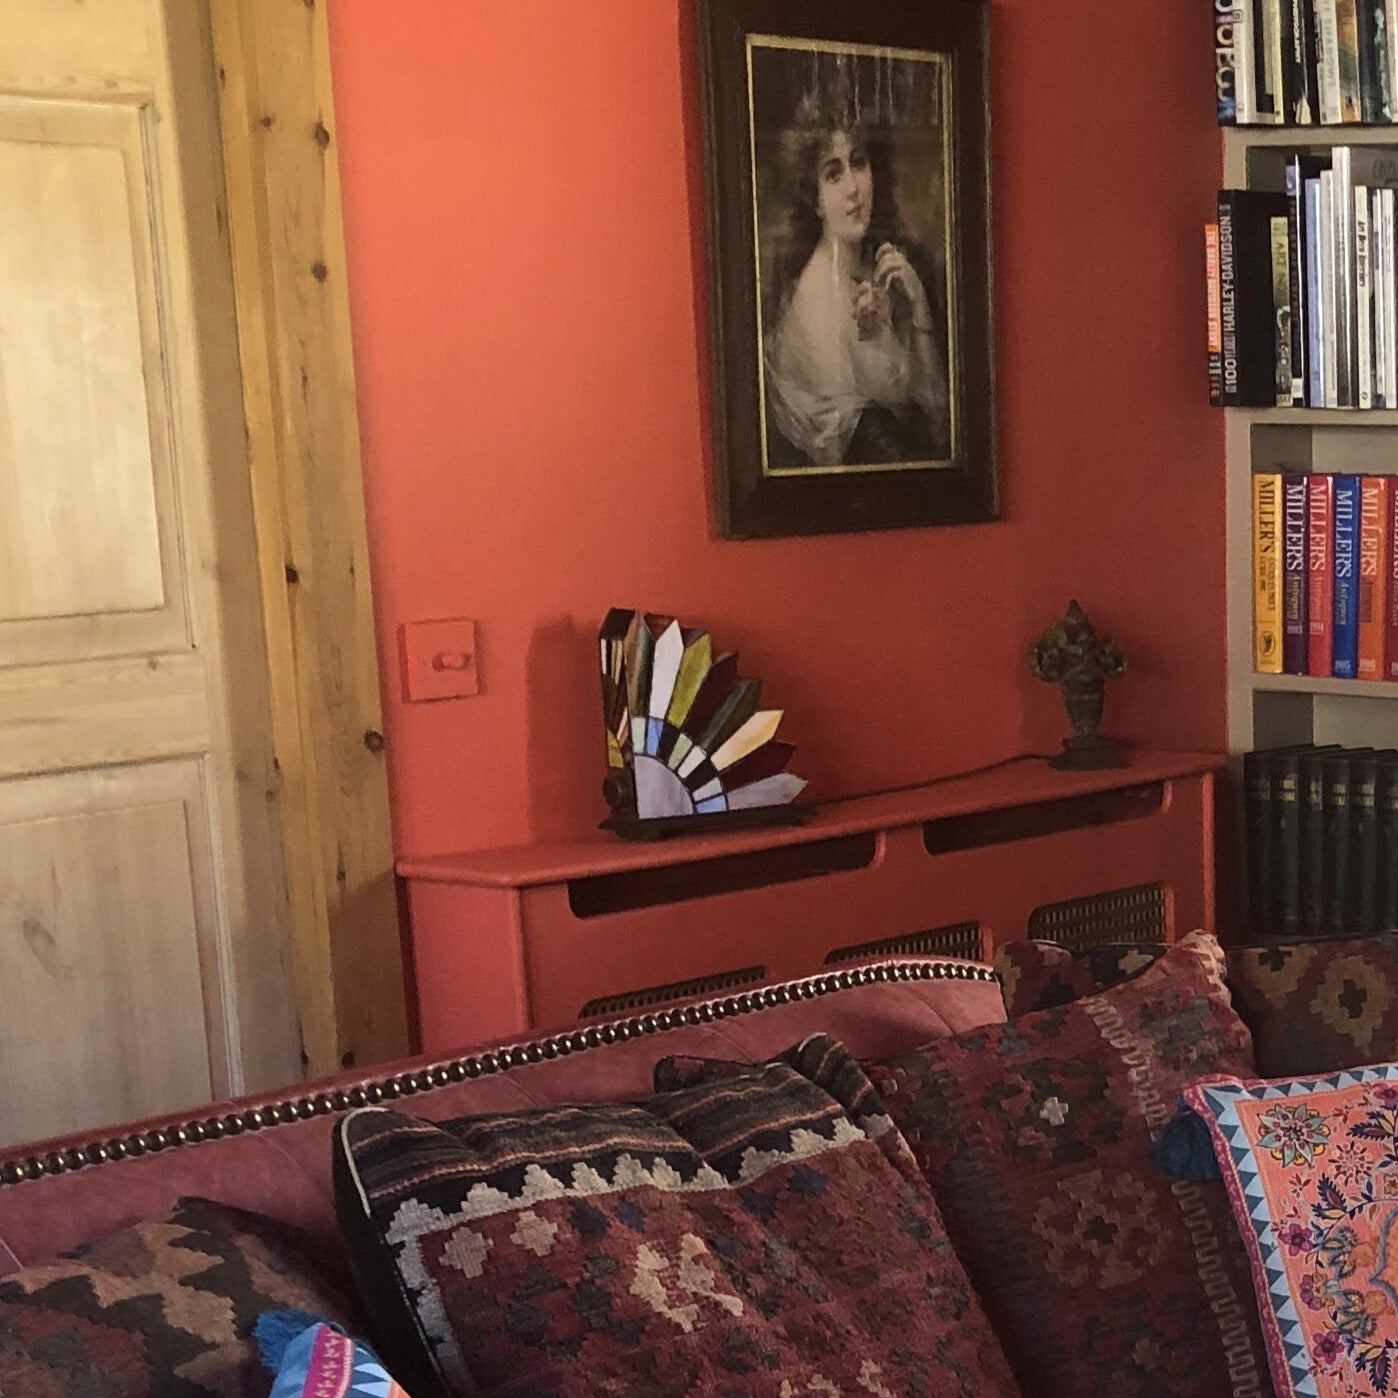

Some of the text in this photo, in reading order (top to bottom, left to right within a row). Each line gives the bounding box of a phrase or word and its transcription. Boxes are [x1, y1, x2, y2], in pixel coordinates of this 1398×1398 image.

[1219, 216, 1235, 331] HARLEY-DAVIDSON
[1225, 358, 1237, 384] 100
[1259, 481, 1275, 553] MILLER'S
[1286, 484, 1303, 570] MILLER'S
[1310, 484, 1326, 570] MILLER'S
[1335, 490, 1353, 577] MILLER'S
[1361, 487, 1378, 576] MILLER'S
